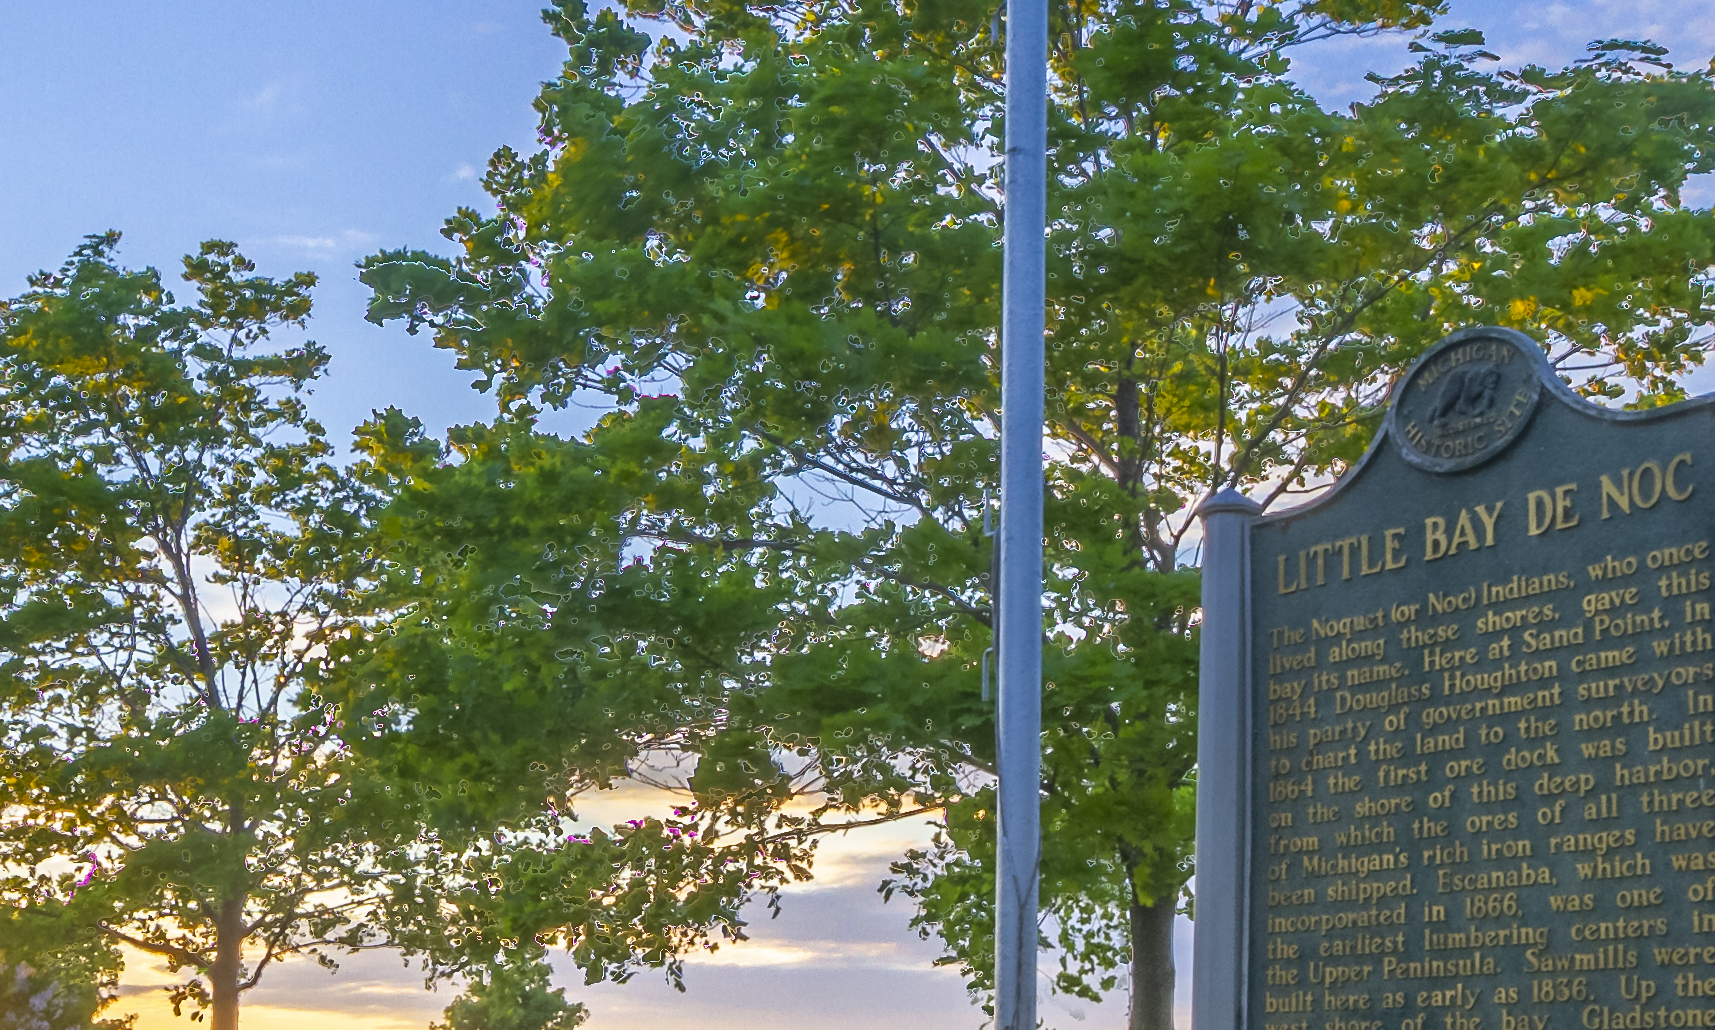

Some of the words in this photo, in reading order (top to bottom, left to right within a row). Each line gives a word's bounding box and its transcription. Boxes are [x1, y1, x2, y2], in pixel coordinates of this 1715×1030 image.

[1417, 343, 1516, 392] MICHIGAN
[1405, 420, 1488, 459] HISTORIC
[1494, 387, 1533, 438] SITE
[1276, 528, 1406, 594] LITTLE
[1424, 501, 1505, 561] BAY
[1527, 484, 1580, 536] DE
[1600, 453, 1694, 520] NOC
[1269, 627, 1306, 649] The
[1311, 608, 1386, 639] Noquet
[1391, 602, 1421, 622] (or
[1428, 586, 1476, 615] Noc)
[1483, 571, 1575, 605] Indians,
[1587, 555, 1638, 581] who
[1646, 540, 1709, 569] once
[1269, 646, 1316, 674] lived
[1329, 638, 1385, 663] along
[1400, 623, 1460, 649] these
[1477, 603, 1560, 635] shores,
[1582, 586, 1639, 618] gave
[1657, 569, 1711, 597] this
[1269, 679, 1306, 701] bay
[1313, 672, 1339, 692] its
[1347, 661, 1410, 686] name.
[1423, 648, 1478, 672] Here
[1488, 635, 1511, 660] at
[1522, 625, 1584, 653] Sand
[1685, 600, 1711, 622] in
[1336, 682, 1431, 714] Douglass
[1443, 659, 1558, 696] Houghton
[1571, 646, 1636, 673] came
[1652, 627, 1713, 657] with
[1269, 730, 1298, 750] his
[1309, 719, 1371, 747] party
[1385, 706, 1410, 732] of
[1422, 683, 1562, 729] government
[1578, 663, 1714, 701] surveyors
[1270, 758, 1291, 776] to
[1301, 745, 1358, 771] chart
[1368, 738, 1404, 761] the
[1416, 726, 1465, 755] land
[1479, 723, 1504, 744] to
[1517, 716, 1558, 739] the
[1574, 699, 1657, 731] north.
[1687, 689, 1714, 714] In
[1269, 775, 1313, 801] 1864
[1328, 772, 1361, 794] the
[1378, 761, 1428, 787] first
[1445, 757, 1485, 778] ore
[1502, 741, 1560, 770] dock
[1581, 737, 1626, 758] was
[1647, 720, 1715, 751] built
[1270, 811, 1293, 827] on
[1308, 802, 1339, 823] the
[1355, 795, 1413, 818] shore
[1429, 784, 1454, 808] of
[1471, 779, 1516, 803] this
[1534, 772, 1595, 797] deep
[1615, 755, 1715, 786] harbor,
[1268, 859, 1289, 880] of
[1302, 847, 1409, 878] Michigan's
[1423, 840, 1469, 866] rich
[1483, 839, 1532, 860] iron
[1549, 828, 1636, 854] ranges
[1269, 833, 1319, 854] from
[1335, 821, 1395, 847] which
[1412, 817, 1448, 838] the
[1466, 811, 1518, 833] ores
[1537, 800, 1565, 825] of
[1584, 793, 1618, 820] all
[1268, 885, 1316, 906] been
[1327, 874, 1418, 904] shipped.
[1438, 862, 1557, 893] Escanaba,
[1576, 853, 1651, 880] which
[1267, 938, 1300, 959] the
[1320, 931, 1406, 956] earliest
[1424, 923, 1549, 950] lumbering
[1571, 916, 1667, 941] centers
[1268, 902, 1406, 935] incorporated
[1424, 901, 1445, 922] in
[1465, 892, 1522, 919] 1866,
[1549, 893, 1594, 912] was
[1616, 887, 1663, 908] one
[1265, 990, 1314, 1013] built
[1324, 989, 1371, 1011] here
[1384, 991, 1405, 1008] as
[1417, 983, 1482, 1010] early
[1494, 986, 1518, 1004] as
[1532, 978, 1595, 1003] 1836.
[1620, 974, 1656, 1003] Up
[1267, 964, 1298, 986] the
[1309, 961, 1372, 988] Upper
[1384, 951, 1501, 980] Peninsula.
[1524, 944, 1637, 973] Sawmills
